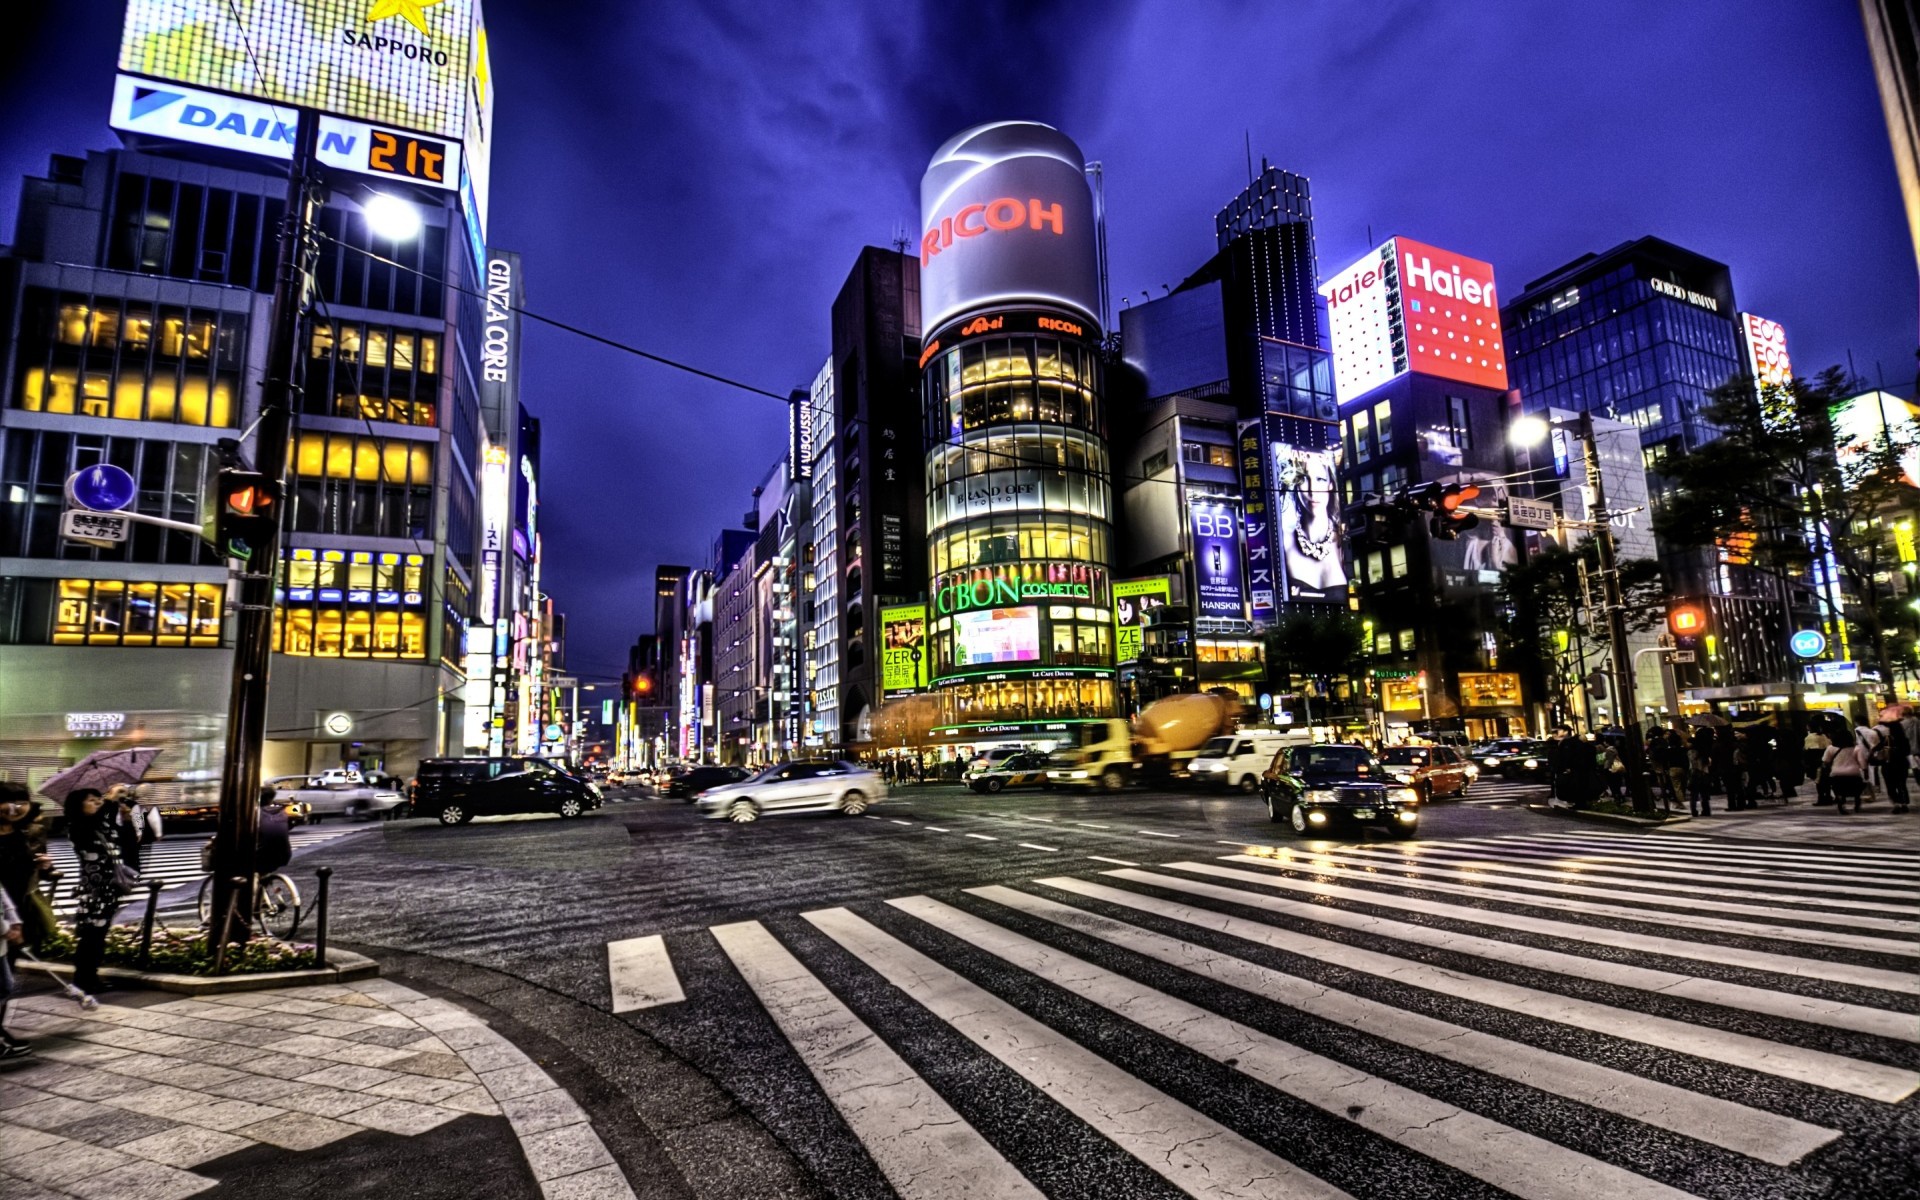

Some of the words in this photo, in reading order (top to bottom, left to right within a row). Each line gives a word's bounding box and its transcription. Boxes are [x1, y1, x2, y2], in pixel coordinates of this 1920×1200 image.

[342, 29, 449, 67] SAPPORO
[178, 103, 358, 157] DAIKN
[920, 196, 1064, 268] RICOH
[486, 258, 512, 321] GINZA
[1404, 251, 1495, 309] Haier
[1650, 276, 1688, 301] GIORGIO
[1686, 289, 1718, 312] ARMANI
[1038, 316, 1083, 337] RICOH
[483, 324, 509, 383] CORE
[800, 401, 812, 478] MAUBOUSSIN
[957, 487, 1001, 505] BRAND
[1005, 484, 1035, 496] OFF
[71, 524, 121, 539] ここから
[1195, 512, 1234, 539] B.B
[1247, 522, 1271, 584] ジオス
[290, 588, 400, 604] イーオン
[1021, 583, 1090, 598] COSMETICS
[1201, 600, 1241, 611] HANSKIN
[66, 713, 123, 722] NISSAN
